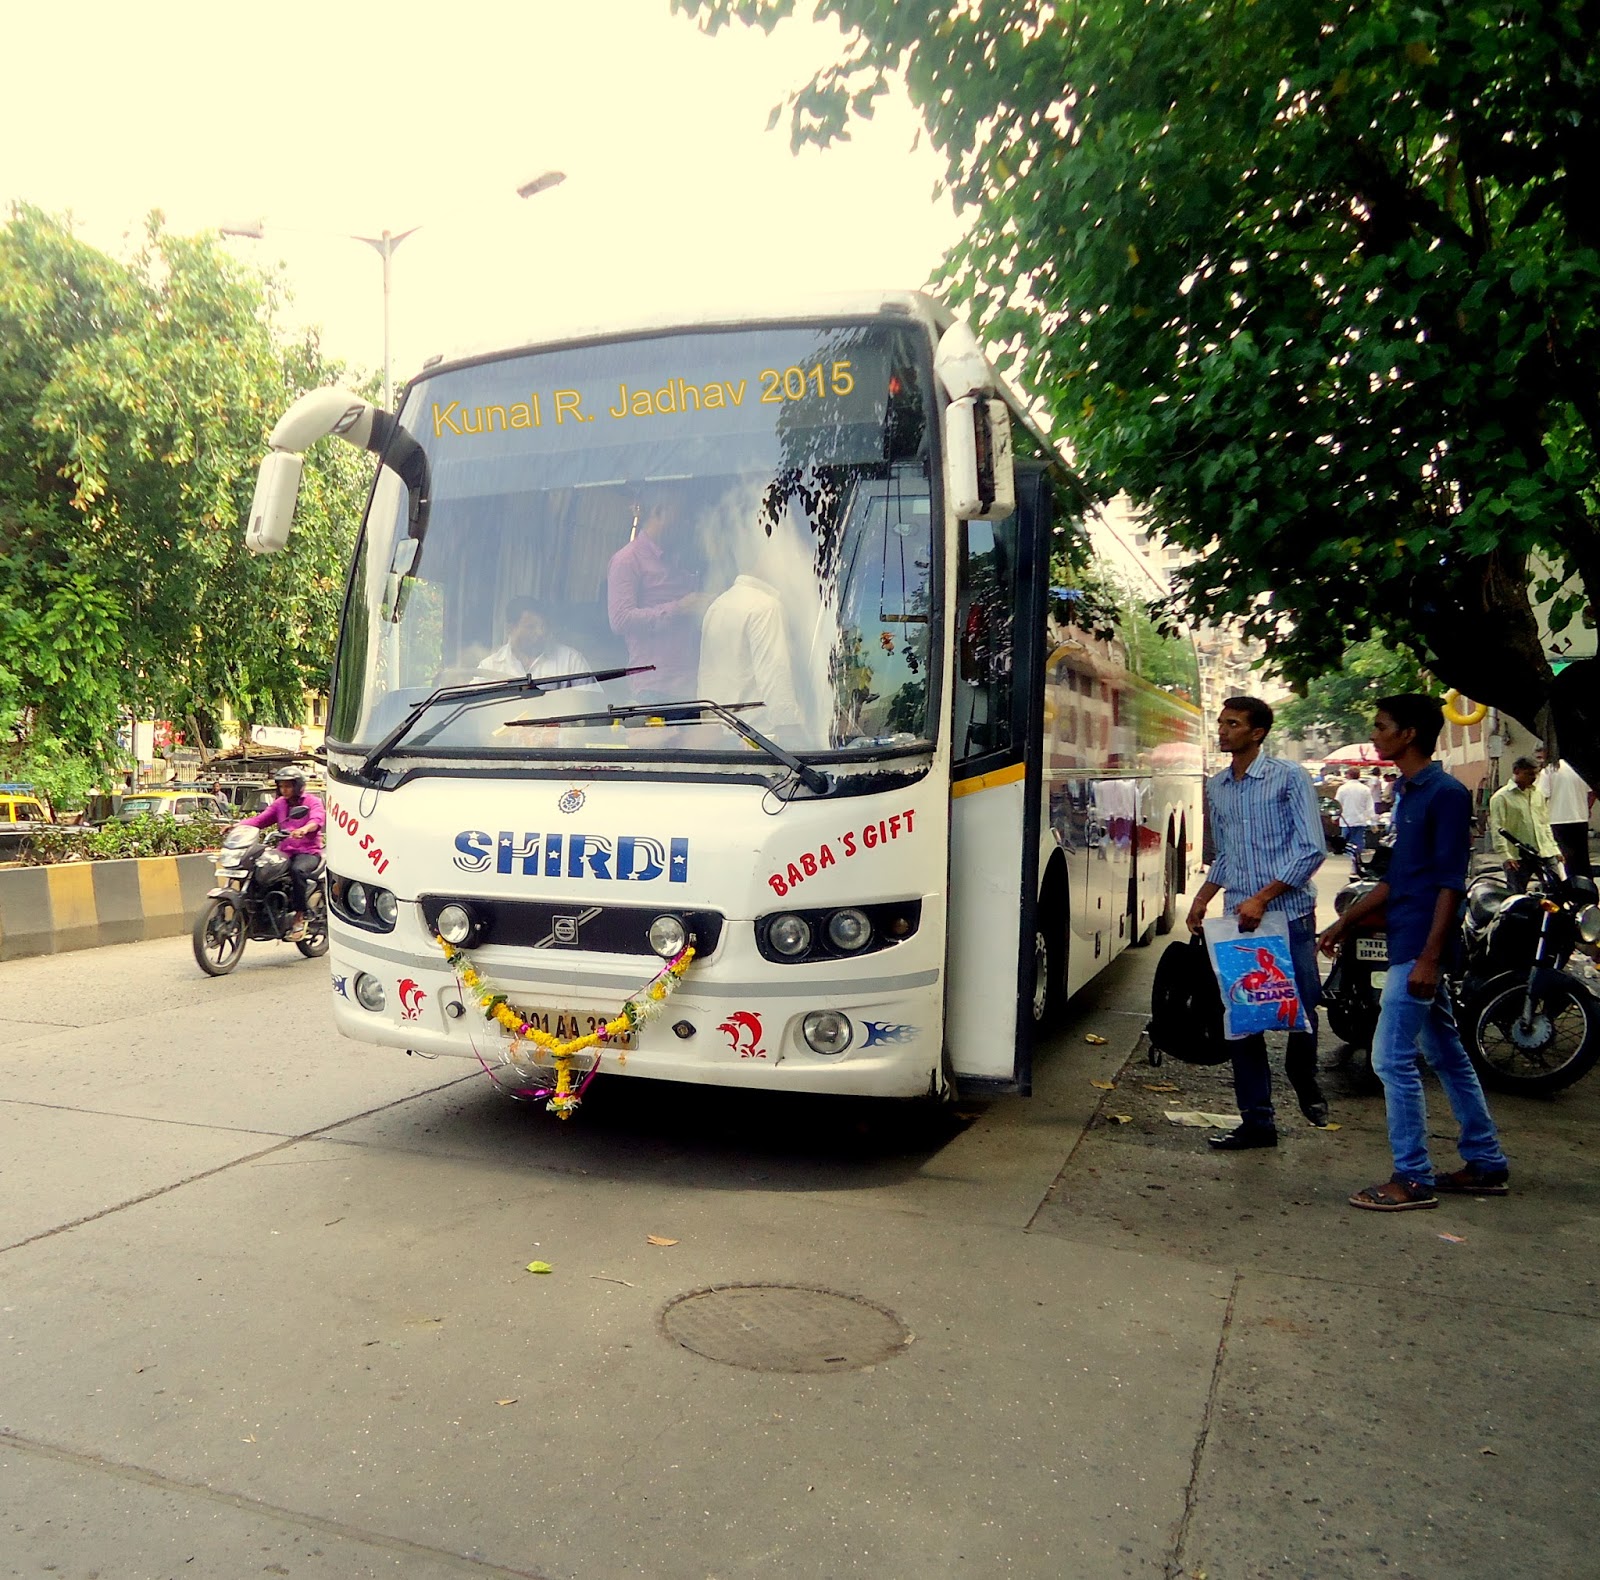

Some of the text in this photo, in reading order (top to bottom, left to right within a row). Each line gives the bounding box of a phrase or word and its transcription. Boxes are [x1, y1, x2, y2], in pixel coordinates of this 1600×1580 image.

[359, 834, 389, 875] SAI
[453, 830, 689, 883] SHIRDI
[768, 809, 915, 896] BABA'S GIFT
[556, 1015, 580, 1039] AA
